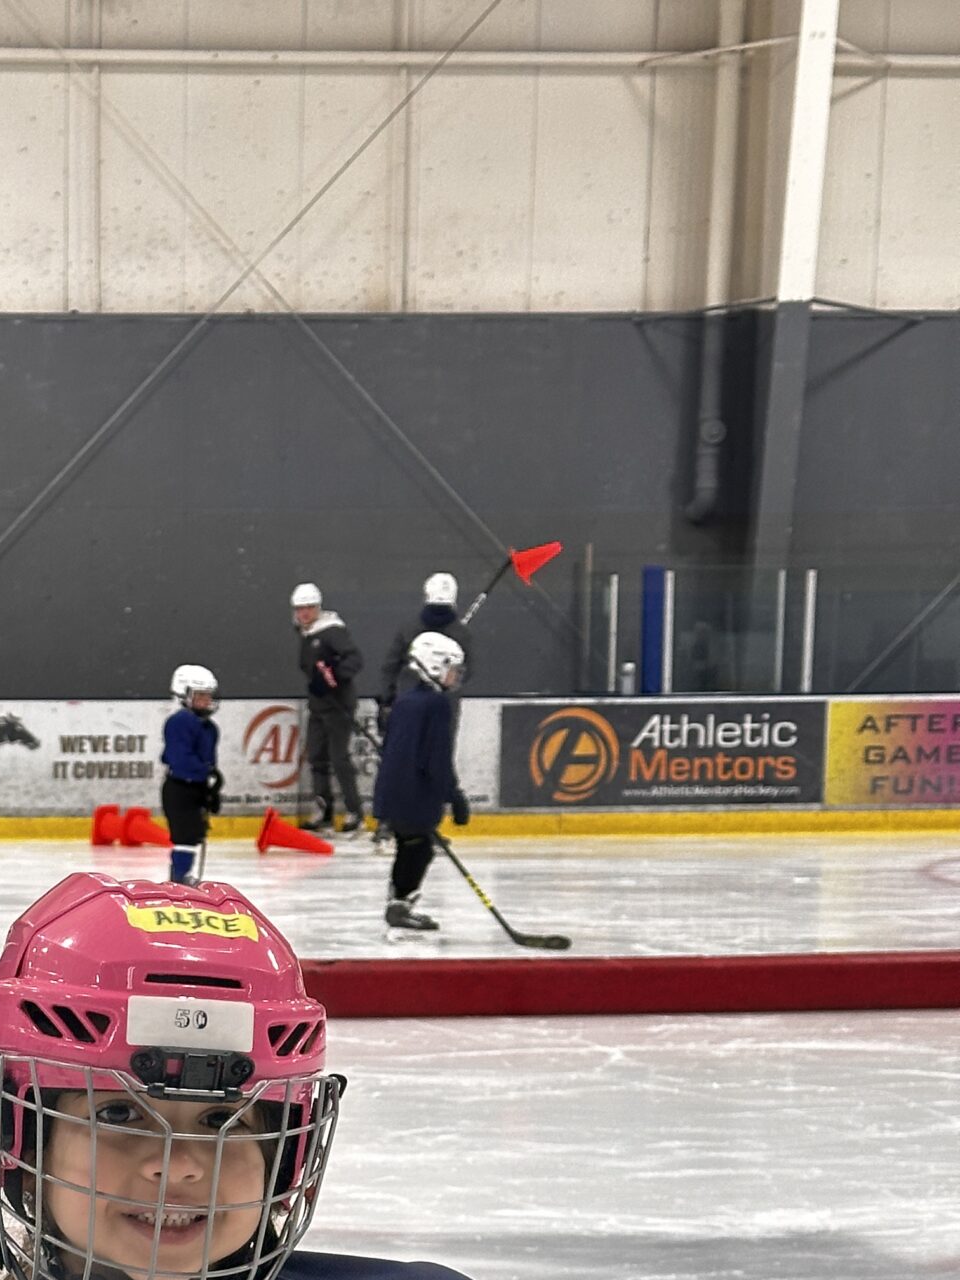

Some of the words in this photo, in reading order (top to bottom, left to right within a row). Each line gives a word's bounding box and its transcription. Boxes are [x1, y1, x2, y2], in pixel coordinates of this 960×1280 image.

[630, 713, 798, 748] Athletic
[113, 735, 148, 753] GOT
[629, 748, 797, 782] Mentors
[863, 745, 960, 765] GAME
[52, 761, 68, 779] IT
[71, 760, 154, 779] COVERED!
[154, 910, 241, 932] ALICE
[175, 1008, 208, 1029] 50
